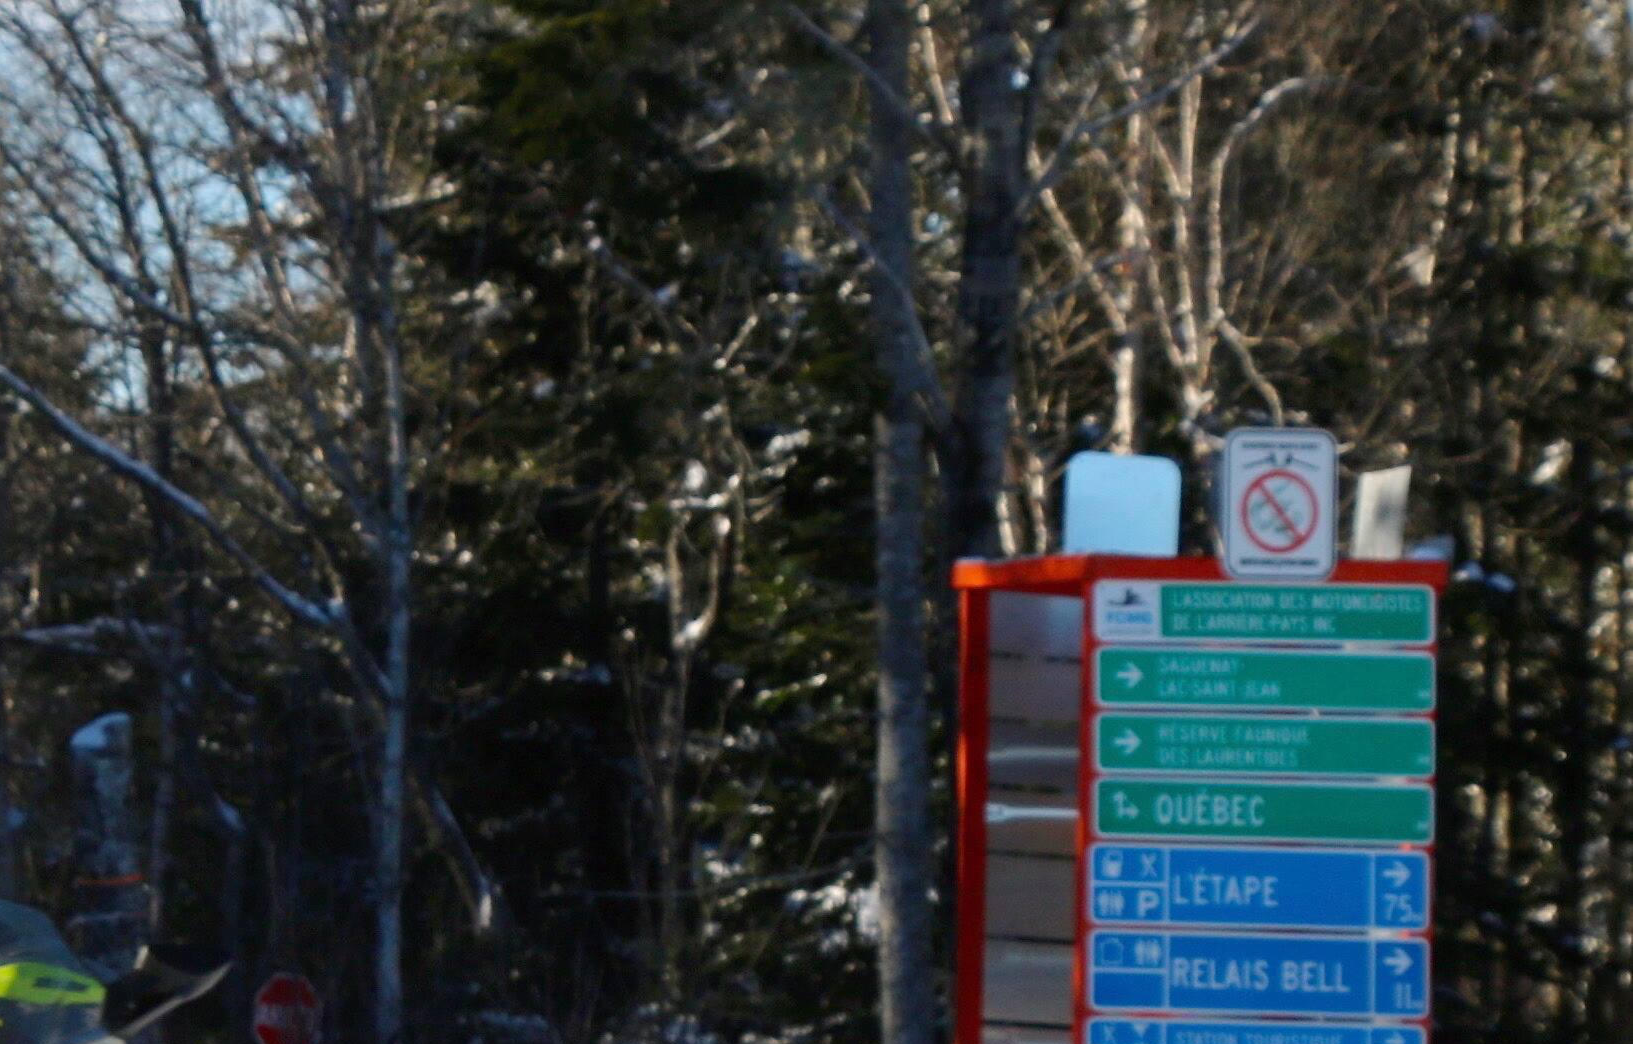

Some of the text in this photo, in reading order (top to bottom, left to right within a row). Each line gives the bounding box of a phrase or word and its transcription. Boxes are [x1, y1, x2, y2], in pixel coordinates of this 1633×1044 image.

[1155, 788, 1265, 827] QUÉBEC
[1172, 867, 1279, 907] L'ÉTAPE
[1383, 892, 1413, 922] 75
[1172, 956, 1351, 993] RELAIS BELL
